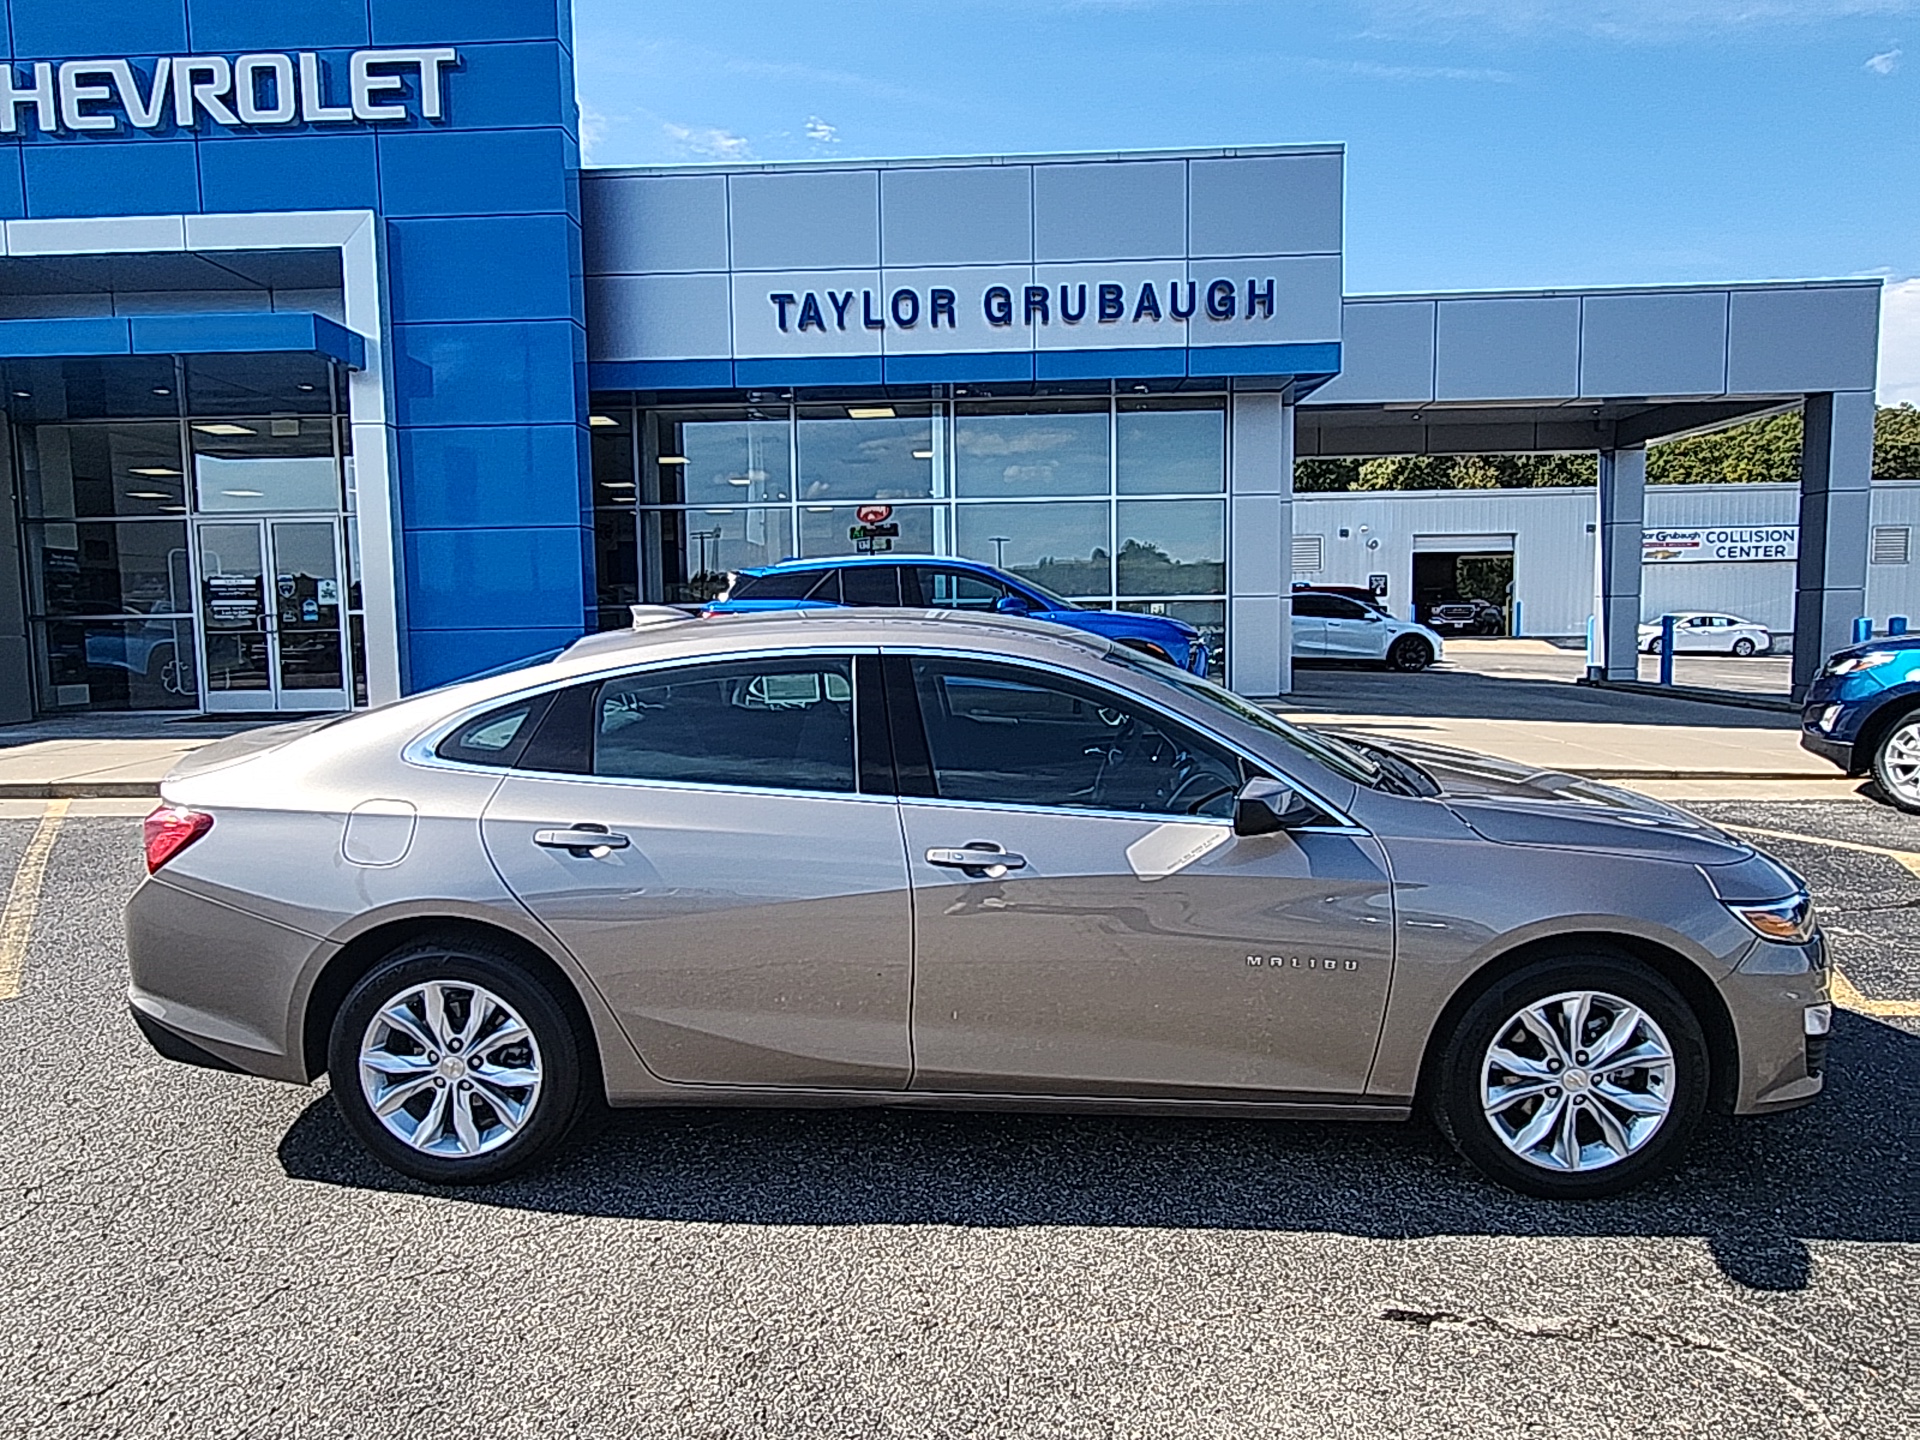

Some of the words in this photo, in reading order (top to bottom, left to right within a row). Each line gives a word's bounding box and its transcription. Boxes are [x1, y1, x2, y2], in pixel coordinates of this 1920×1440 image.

[0, 46, 457, 131] HEVROLET
[769, 287, 957, 333] TAYLOR
[983, 278, 1276, 328] GRUBAUGH
[1706, 530, 1794, 544] COLLISION
[1716, 545, 1786, 559] CENTER
[1246, 955, 1359, 971] MALIBU
